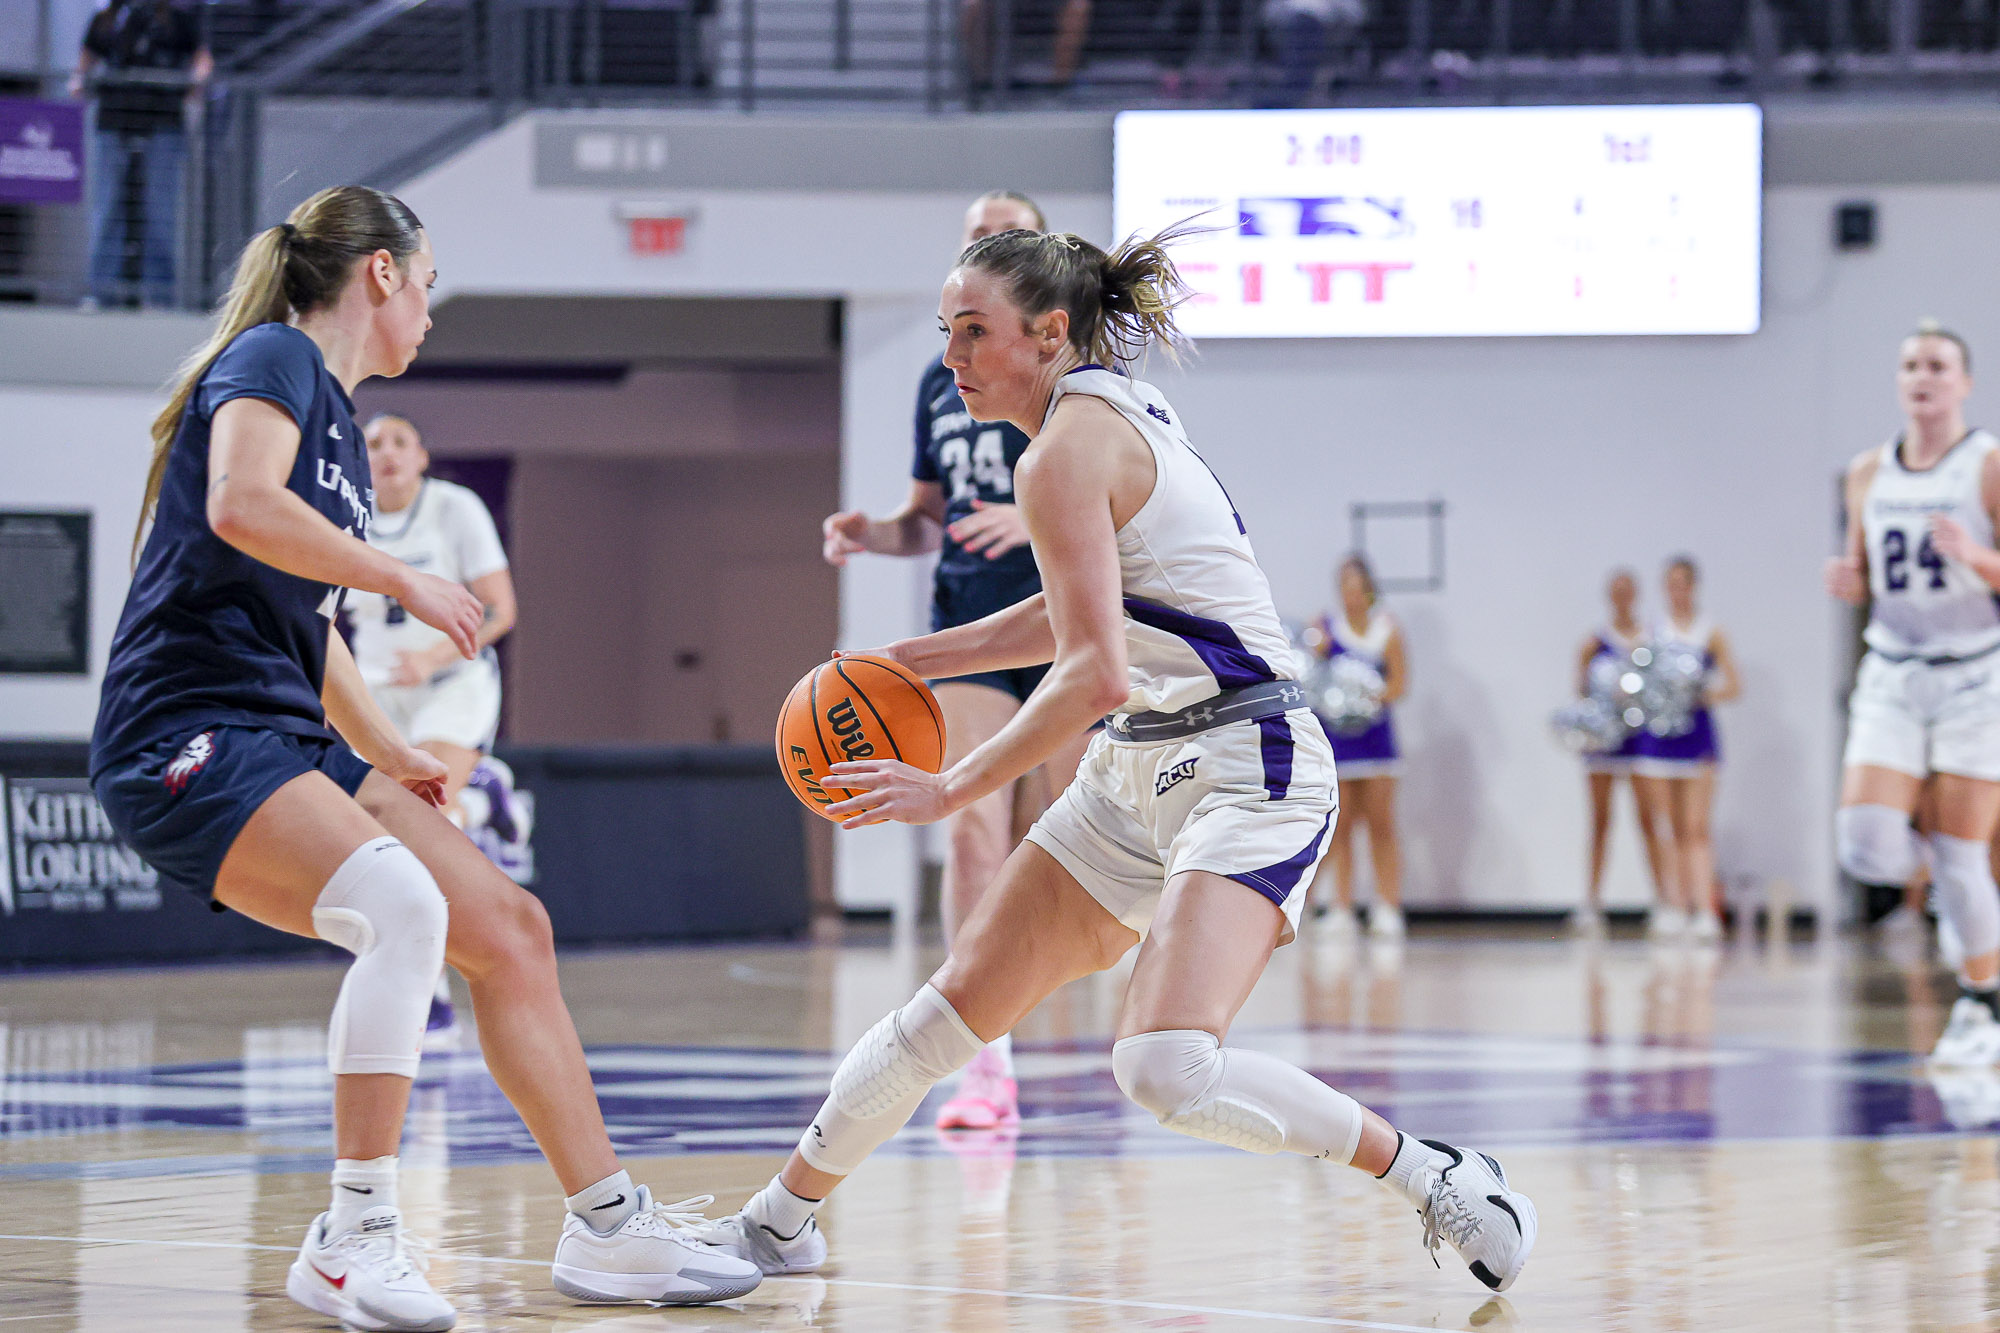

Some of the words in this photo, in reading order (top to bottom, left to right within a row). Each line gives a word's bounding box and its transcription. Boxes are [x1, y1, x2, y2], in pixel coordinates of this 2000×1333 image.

[940, 429, 1013, 502] 24
[1884, 528, 1947, 591] 24
[1156, 756, 1200, 797] ACU
